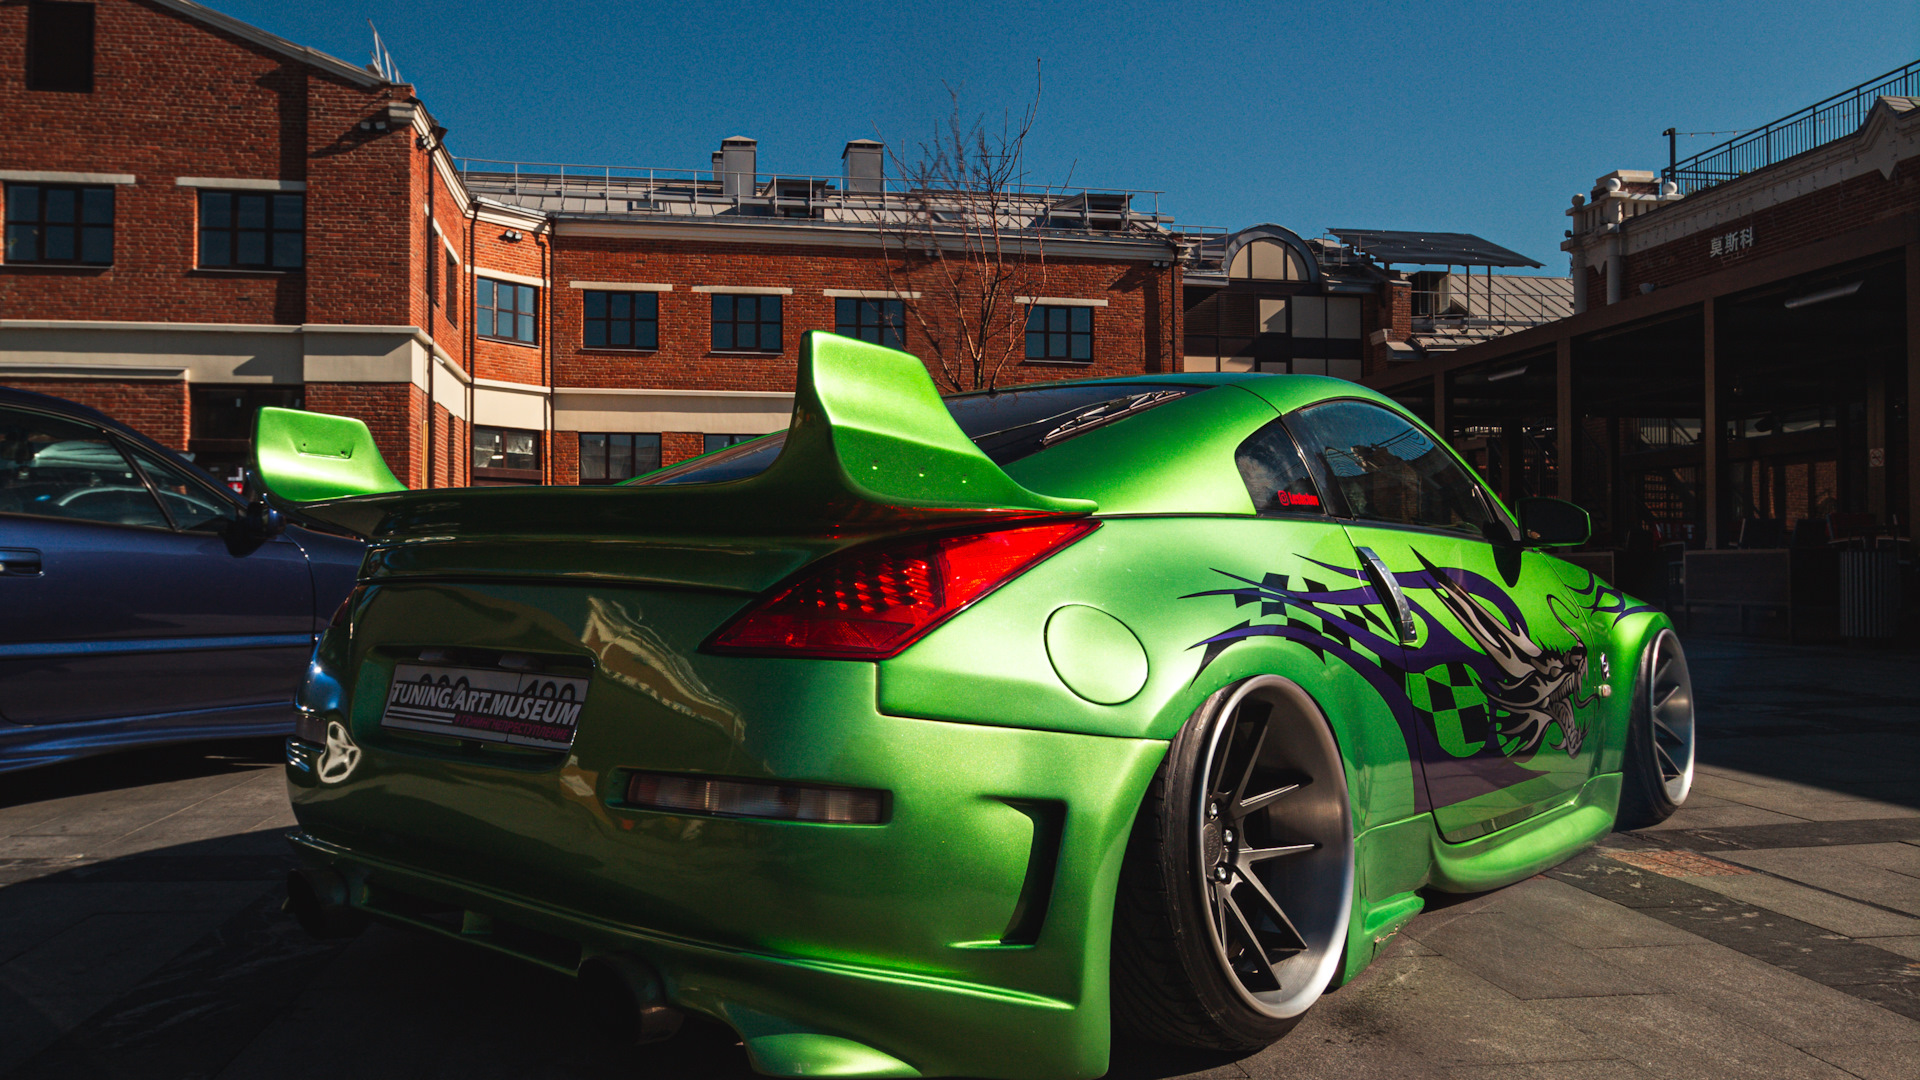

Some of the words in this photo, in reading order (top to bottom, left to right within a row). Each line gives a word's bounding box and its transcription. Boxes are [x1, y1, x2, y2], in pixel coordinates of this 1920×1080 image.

[1709, 226, 1754, 258] 莫斯科
[391, 683, 582, 726] TUNING.ART.MUSEUM
